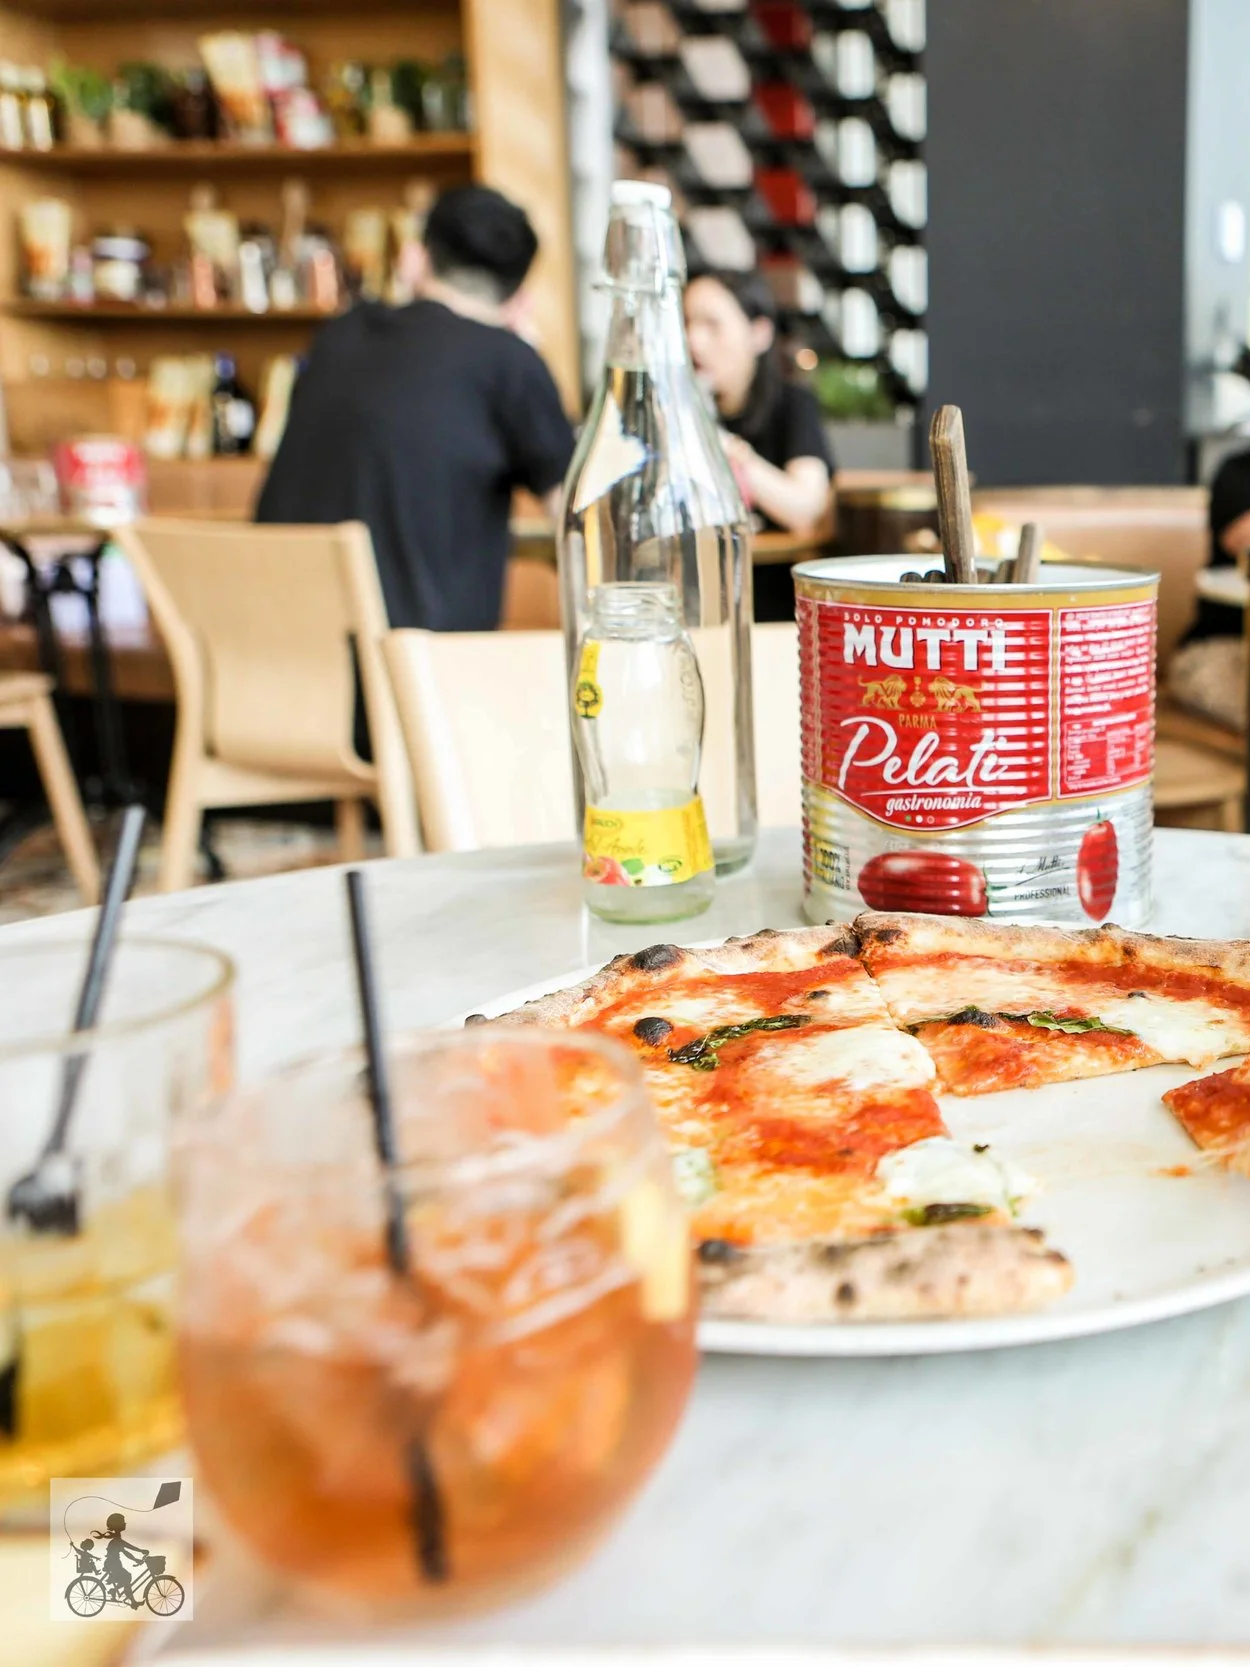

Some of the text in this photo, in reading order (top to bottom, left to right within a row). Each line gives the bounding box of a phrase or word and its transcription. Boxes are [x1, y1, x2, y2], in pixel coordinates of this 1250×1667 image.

[844, 612, 1005, 627] SOLO POMODORO
[843, 623, 1006, 671] MUTTI
[898, 714, 938, 729] PARMA
[838, 715, 1009, 790] Pelati
[885, 793, 983, 816] gastronomia
